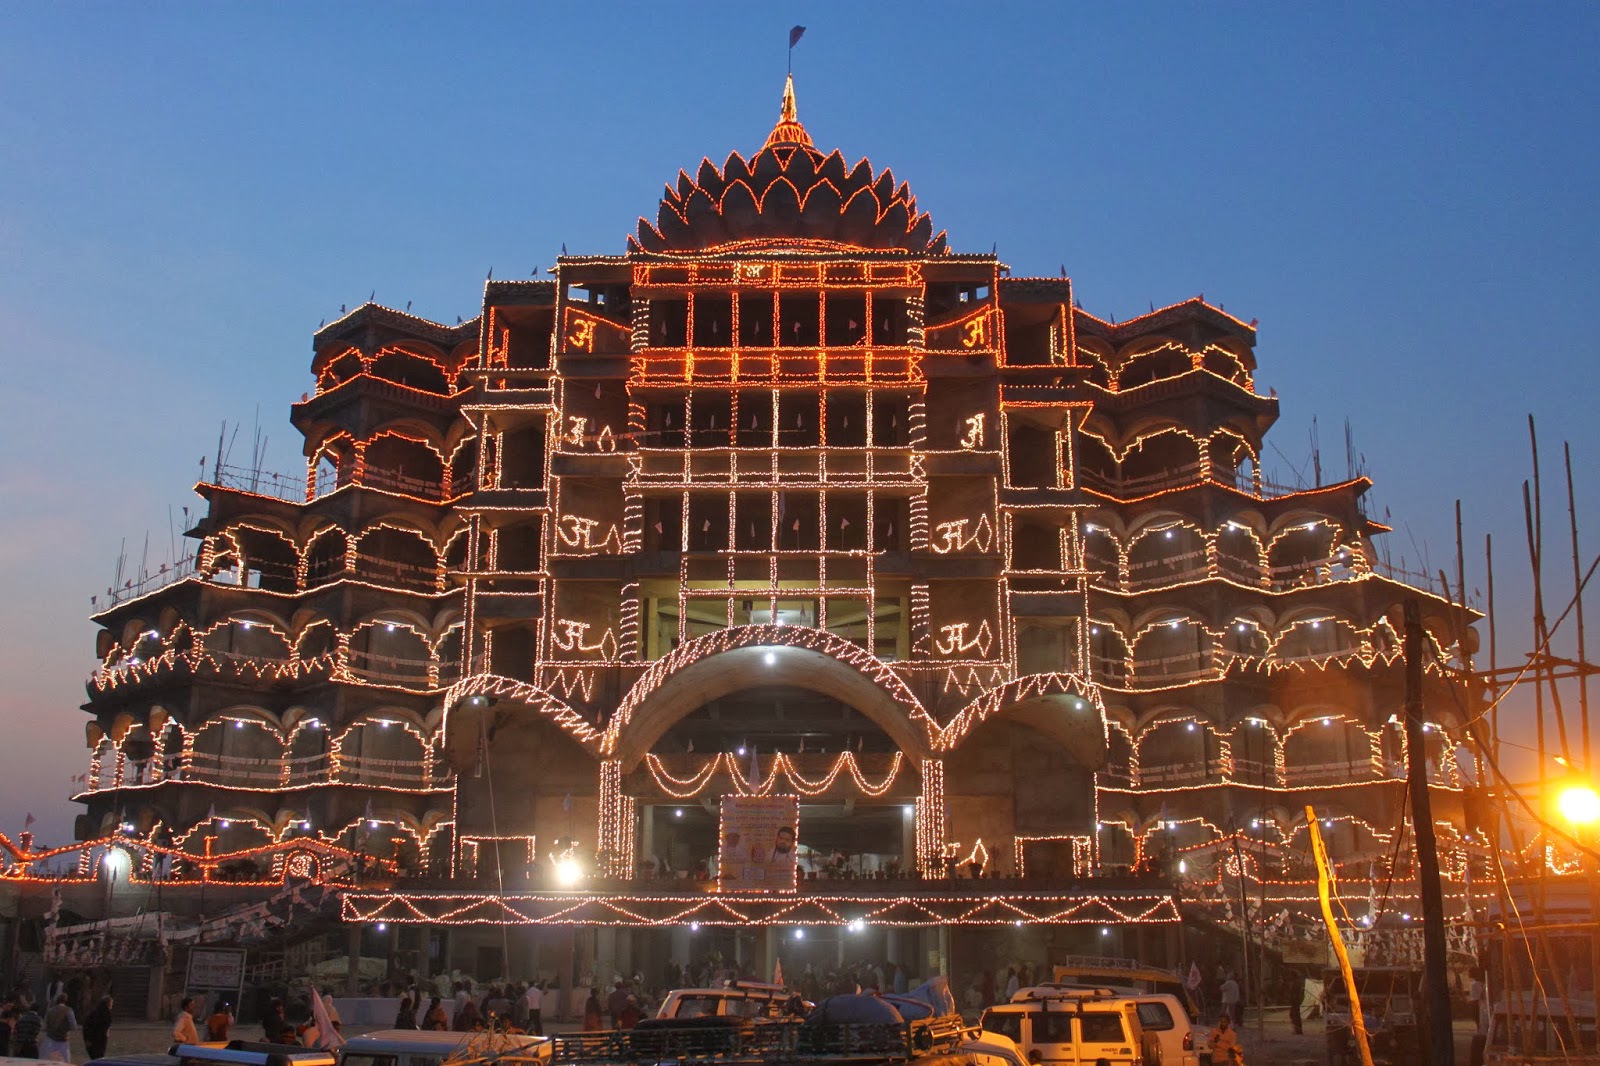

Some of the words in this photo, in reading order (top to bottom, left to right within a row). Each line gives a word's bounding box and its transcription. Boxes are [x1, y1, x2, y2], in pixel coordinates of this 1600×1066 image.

[569, 319, 596, 353] अ
[962, 315, 986, 347] अ
[961, 412, 985, 448] अ
[558, 515, 599, 549] अ
[932, 518, 969, 553] अ
[552, 619, 591, 650] अ
[936, 622, 969, 654] अ
